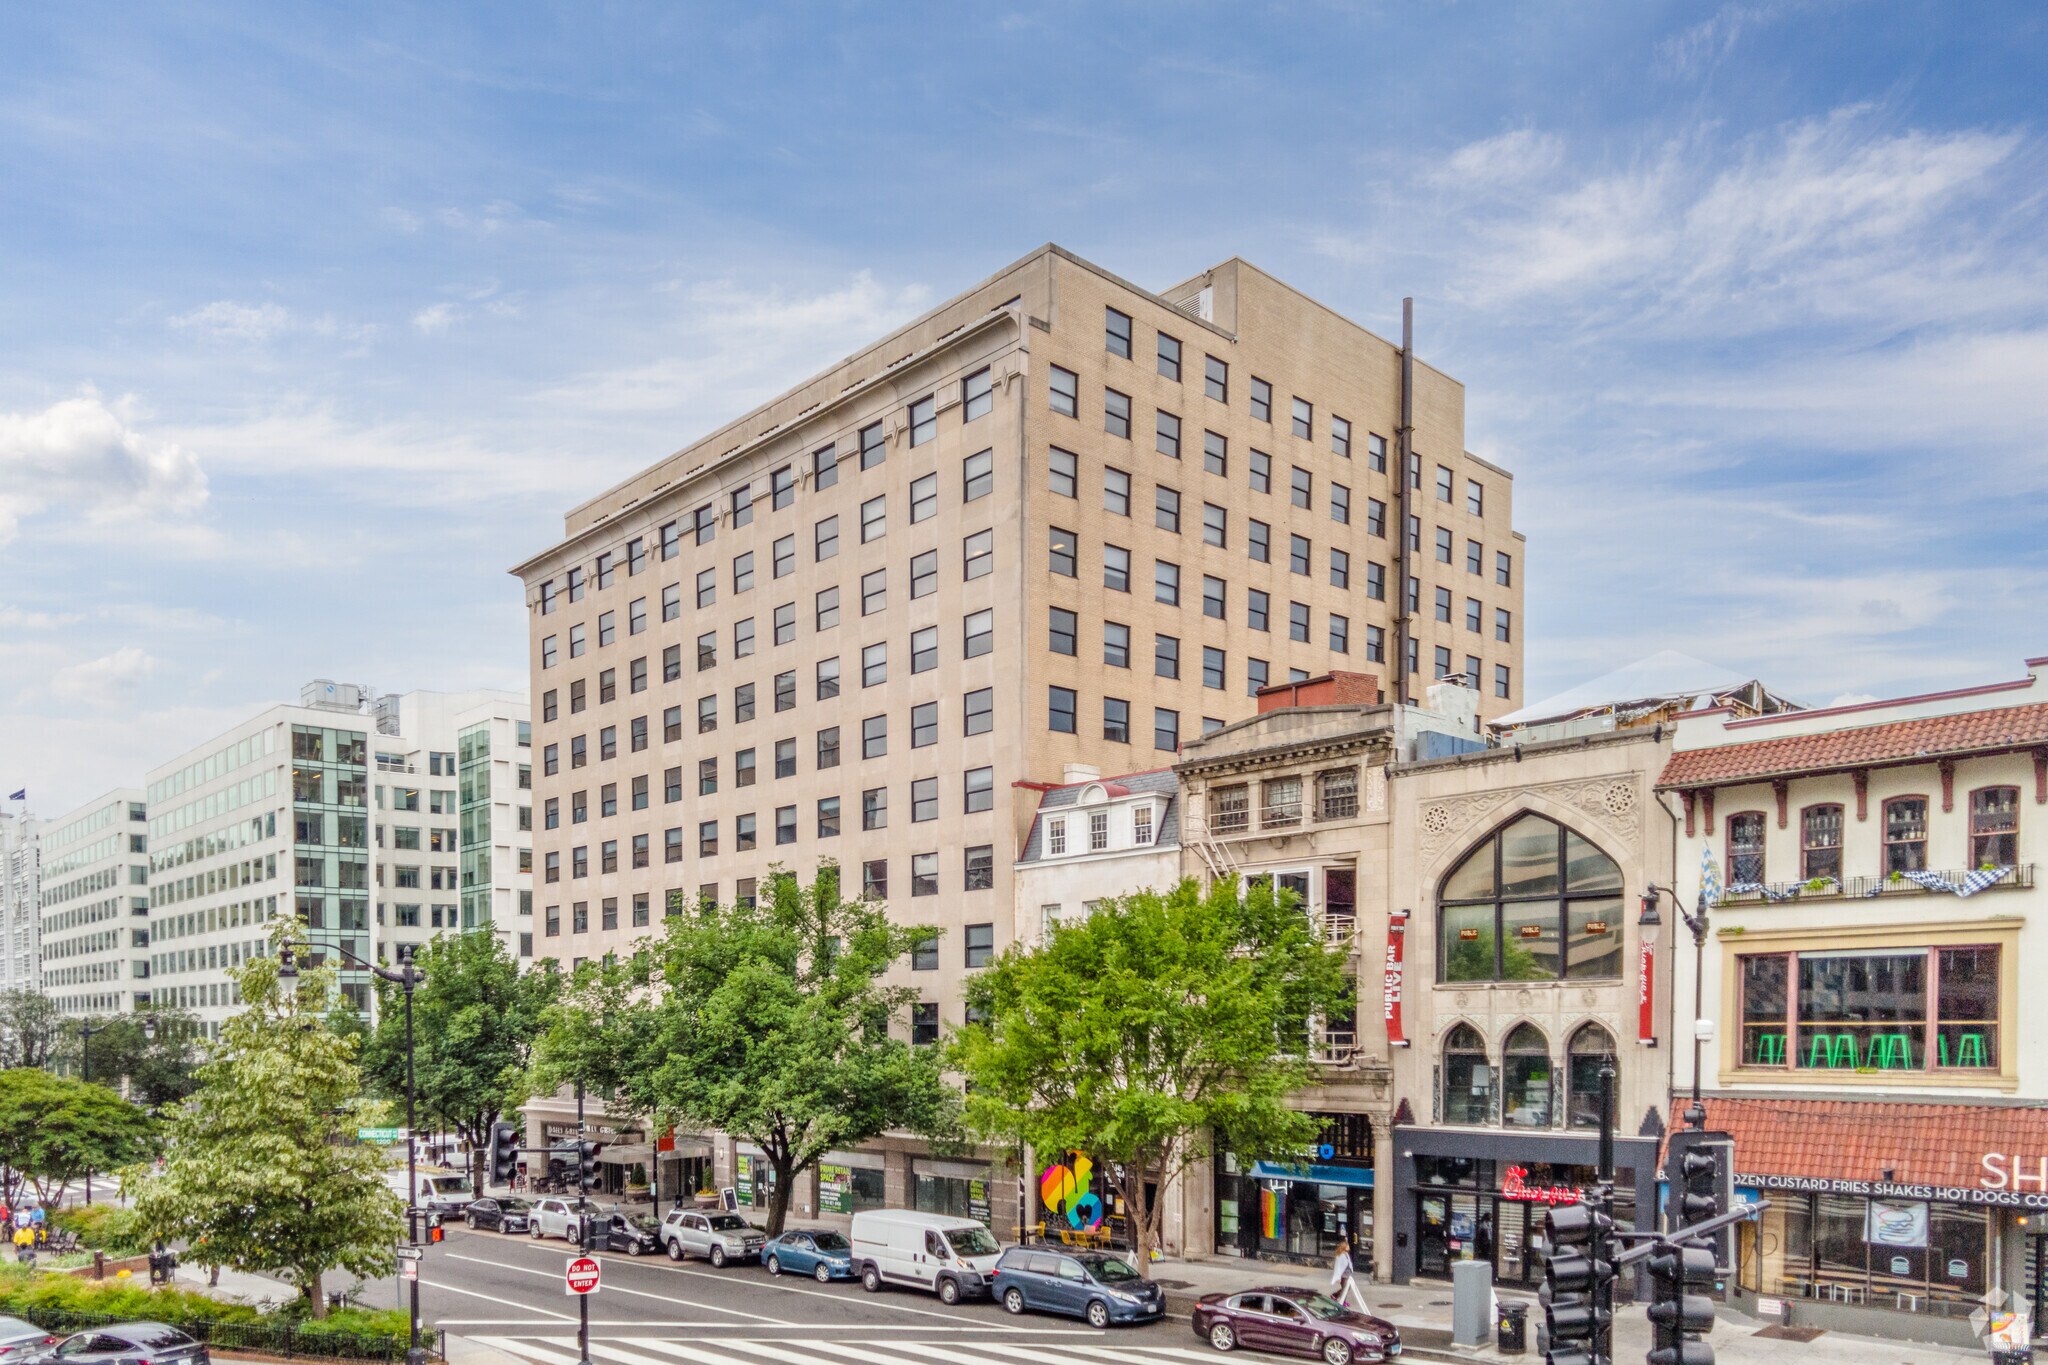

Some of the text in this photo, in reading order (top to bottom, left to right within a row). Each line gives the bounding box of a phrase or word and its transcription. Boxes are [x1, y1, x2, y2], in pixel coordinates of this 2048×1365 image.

[1384, 944, 1396, 1020] PUBLIC BAR
[1391, 961, 1402, 1003] LIVE
[1979, 1152, 2048, 1192] SH
[1768, 1176, 1829, 1190] CUSTARD
[1832, 1181, 1870, 1194] FRIES
[1873, 1183, 1932, 1199] SHAKES
[1936, 1188, 1970, 1201] HOT
[1973, 1191, 2020, 1205] DOGS
[571, 1263, 596, 1273] DO NOT
[573, 1279, 593, 1288] ENTER
